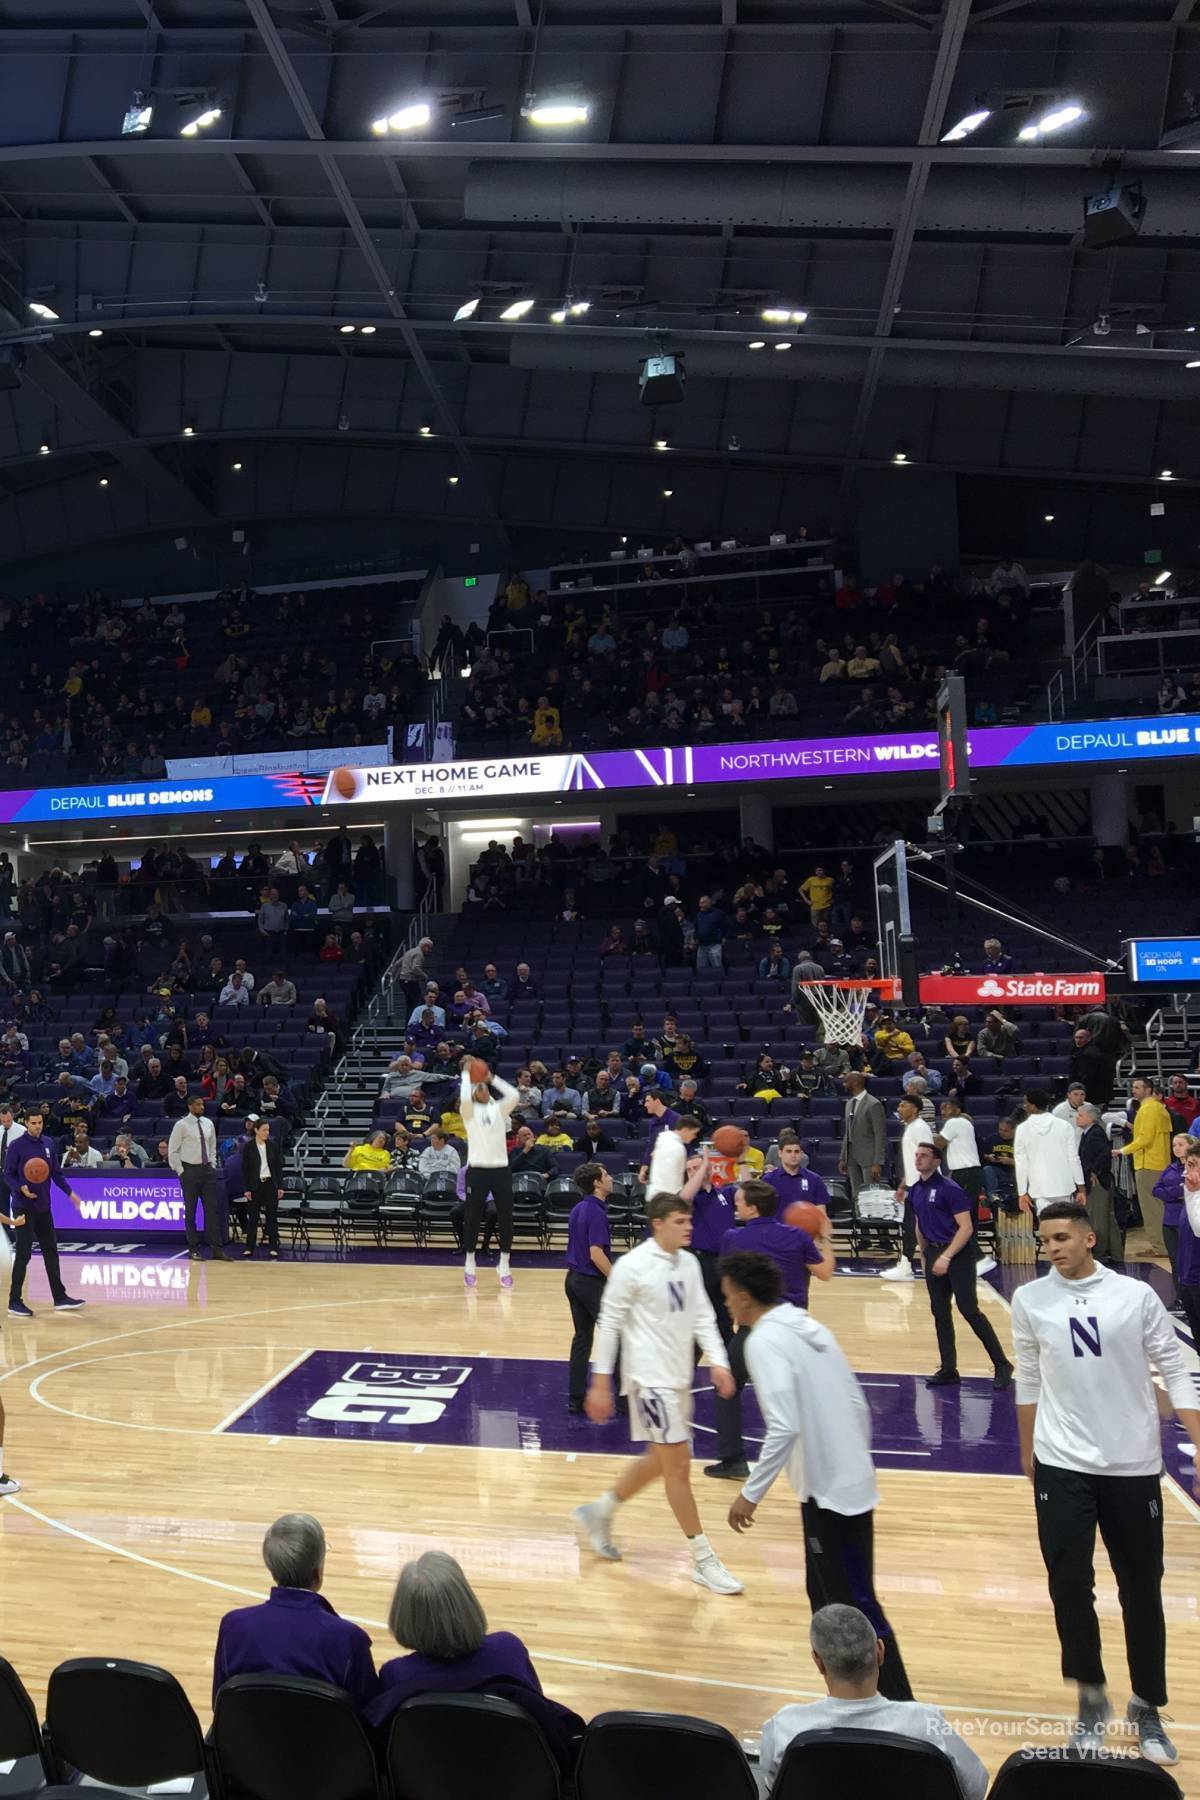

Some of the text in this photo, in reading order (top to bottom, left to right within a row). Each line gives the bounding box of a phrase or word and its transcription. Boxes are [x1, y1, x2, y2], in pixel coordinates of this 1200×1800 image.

[1056, 732, 1132, 751] DEPAUL
[1137, 728, 1190, 745] BLUE
[720, 744, 973, 770] NORTHWESTERN WILDCS
[367, 762, 542, 786] NEXT HOME GAME
[51, 788, 213, 811] DEPAUL BLUE DEMONS
[415, 786, 436, 795] DEC.
[439, 785, 445, 794] 8
[467, 783, 484, 792] AM
[104, 1186, 184, 1198] NORTHWESTE
[80, 1201, 186, 1221] WILDCAT
[667, 1281, 686, 1312] N
[1069, 1316, 1103, 1357] N
